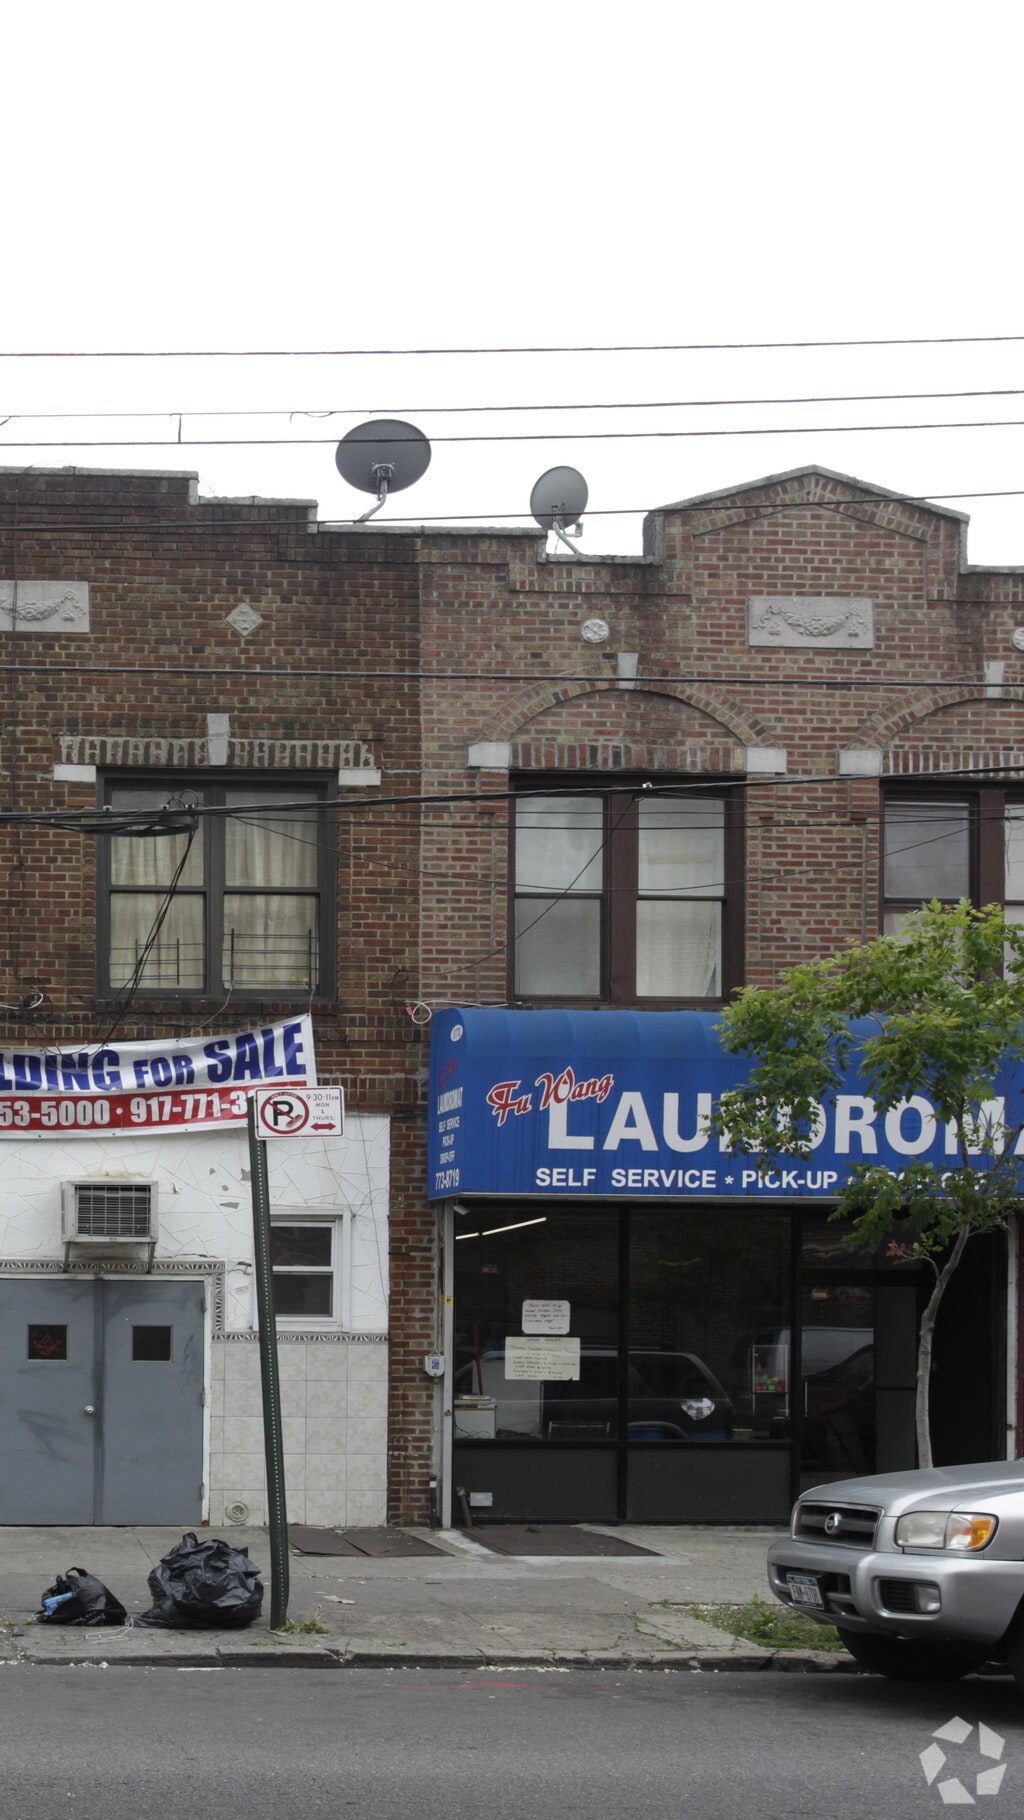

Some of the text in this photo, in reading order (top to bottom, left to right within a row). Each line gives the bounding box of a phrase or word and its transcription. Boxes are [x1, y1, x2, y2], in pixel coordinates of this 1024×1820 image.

[133, 1055, 195, 1088] FOR
[204, 1022, 307, 1083] SALE
[130, 1089, 255, 1123] 917-771-3
[486, 1066, 614, 1127] Fu Wang
[548, 1091, 1024, 1156] LAUDROM
[535, 1168, 838, 1188] SELF SERVICE PICK-UP
